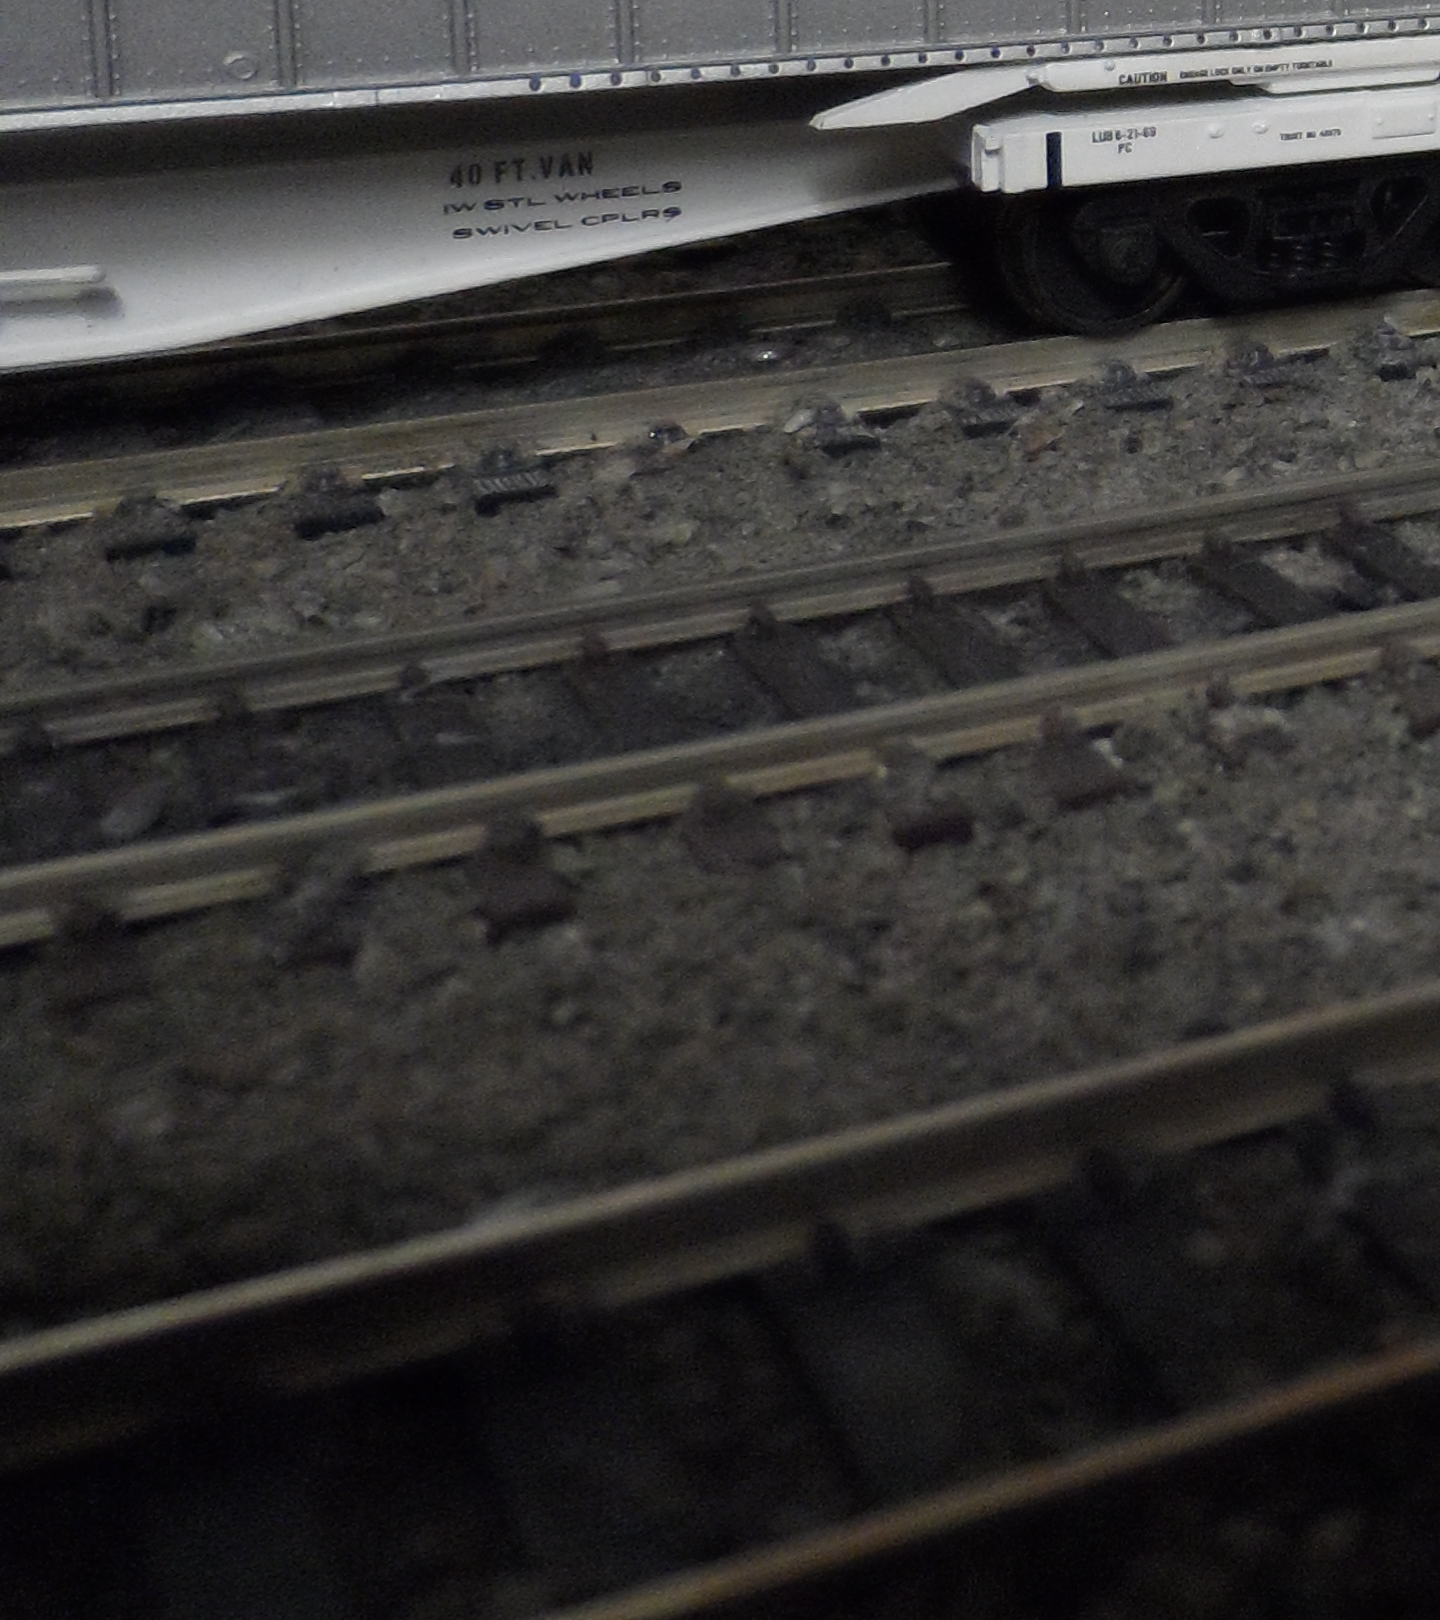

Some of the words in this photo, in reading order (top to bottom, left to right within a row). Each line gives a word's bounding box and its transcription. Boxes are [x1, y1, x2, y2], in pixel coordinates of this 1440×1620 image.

[1118, 70, 1168, 86] CAUTION
[449, 162, 483, 189] 40
[484, 196, 547, 212] STL
[554, 180, 683, 203] WHEELS
[452, 220, 573, 240] SWIVEL
